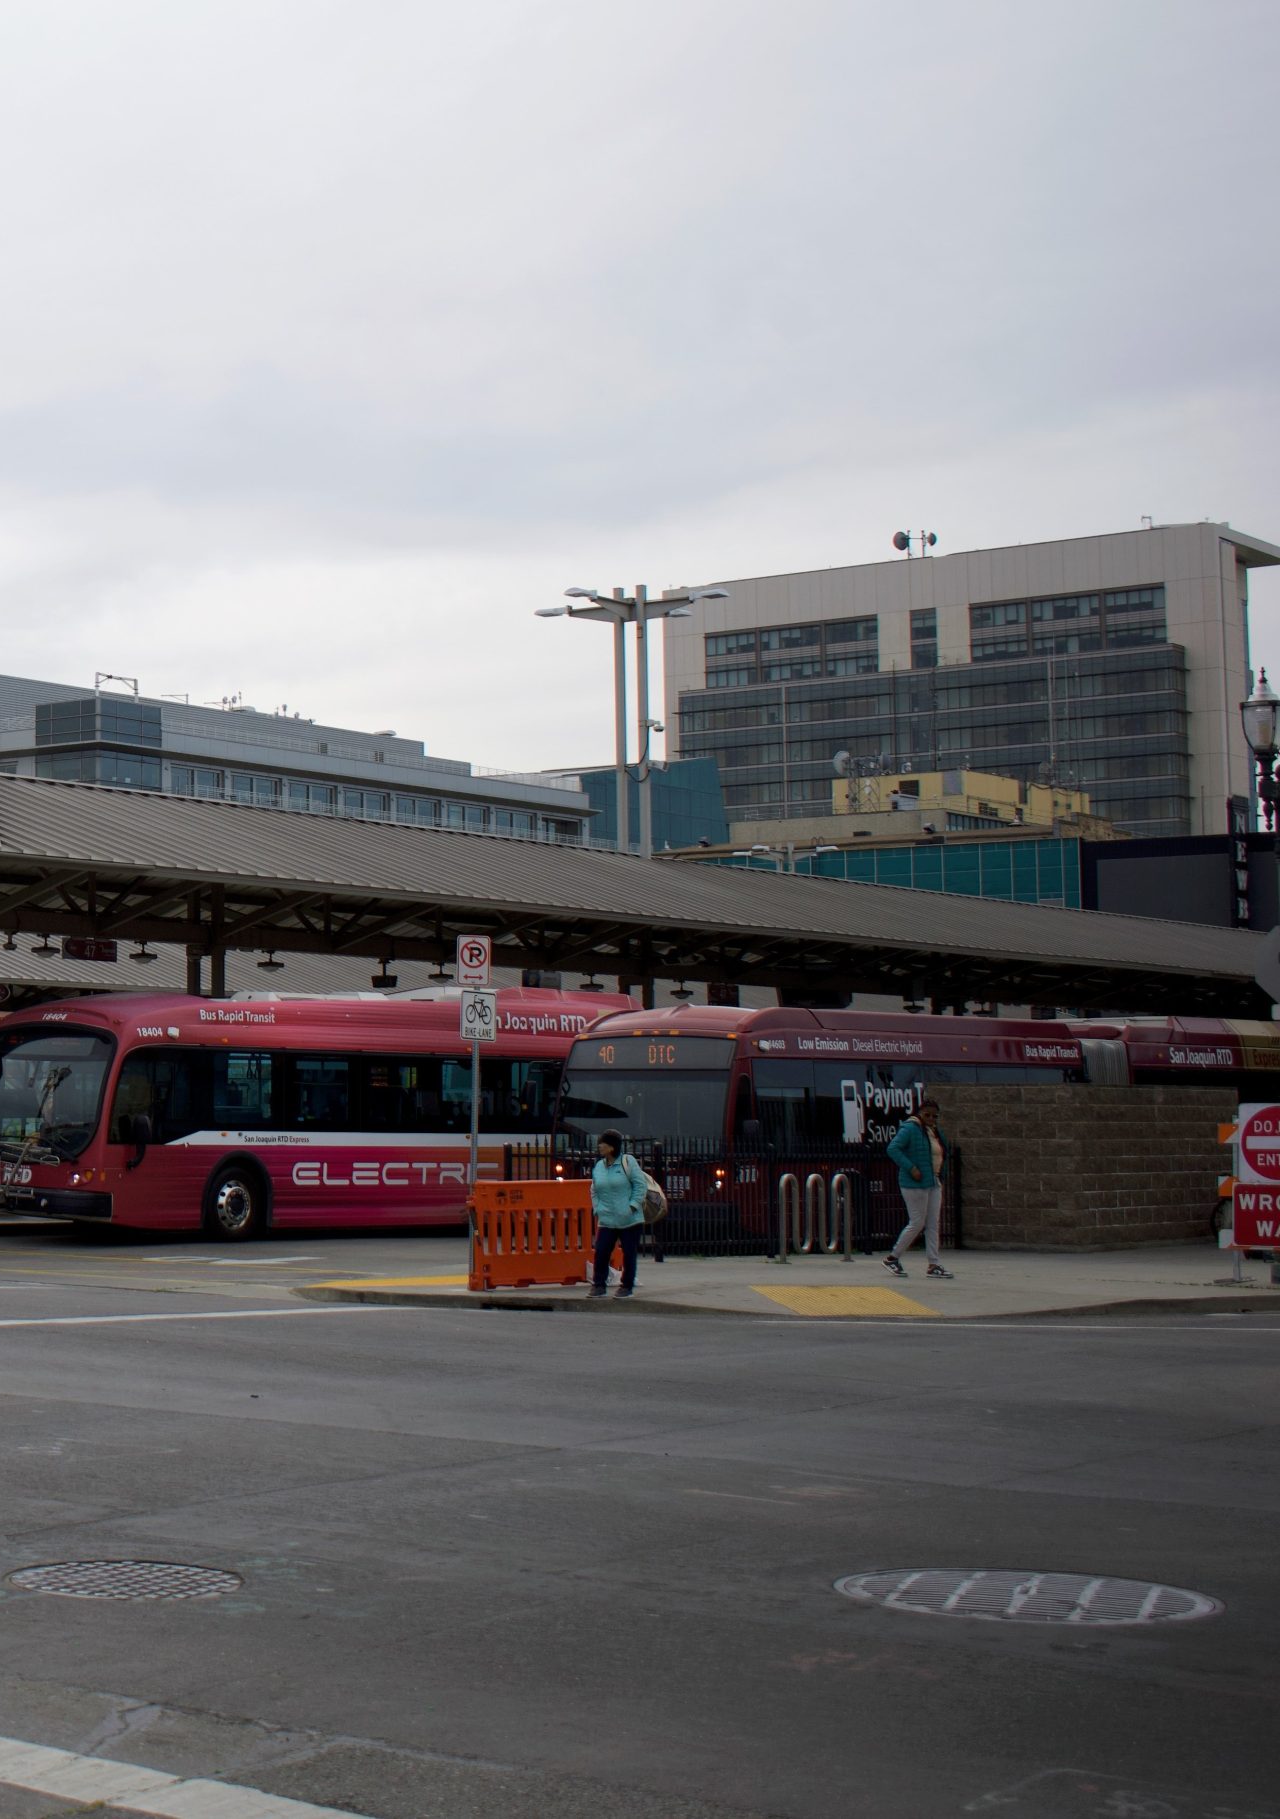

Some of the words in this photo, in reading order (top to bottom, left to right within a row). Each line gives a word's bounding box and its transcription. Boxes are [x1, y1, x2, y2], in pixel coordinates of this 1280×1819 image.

[200, 1009, 216, 1021] Bus
[218, 1009, 244, 1024] Rapid
[245, 1010, 275, 1024] Transit
[505, 1012, 557, 1035] Joaquin
[560, 1015, 587, 1033] RTD
[137, 1027, 163, 1037] 18404
[598, 1045, 615, 1064] 40
[648, 1045, 676, 1064] DTC
[797, 1036, 814, 1050] Low
[815, 1037, 849, 1051] Emission
[852, 1038, 874, 1052] Diesel
[874, 1039, 900, 1053] Electric
[900, 1040, 923, 1055] Hybrid
[1025, 1044, 1038, 1057] Bus
[1038, 1045, 1057, 1059] Rapid
[1057, 1046, 1079, 1059] Transit
[1170, 1049, 1185, 1064] San
[1185, 1050, 1216, 1067] Joaquin
[1216, 1050, 1233, 1065] RTD
[864, 1081, 913, 1115] Paying
[867, 1120, 897, 1143] Save
[1253, 1120, 1273, 1133] DO
[244, 1135, 254, 1143] San
[255, 1135, 276, 1144] Joaquin
[277, 1135, 289, 1143] RTD
[289, 1135, 309, 1144] Express
